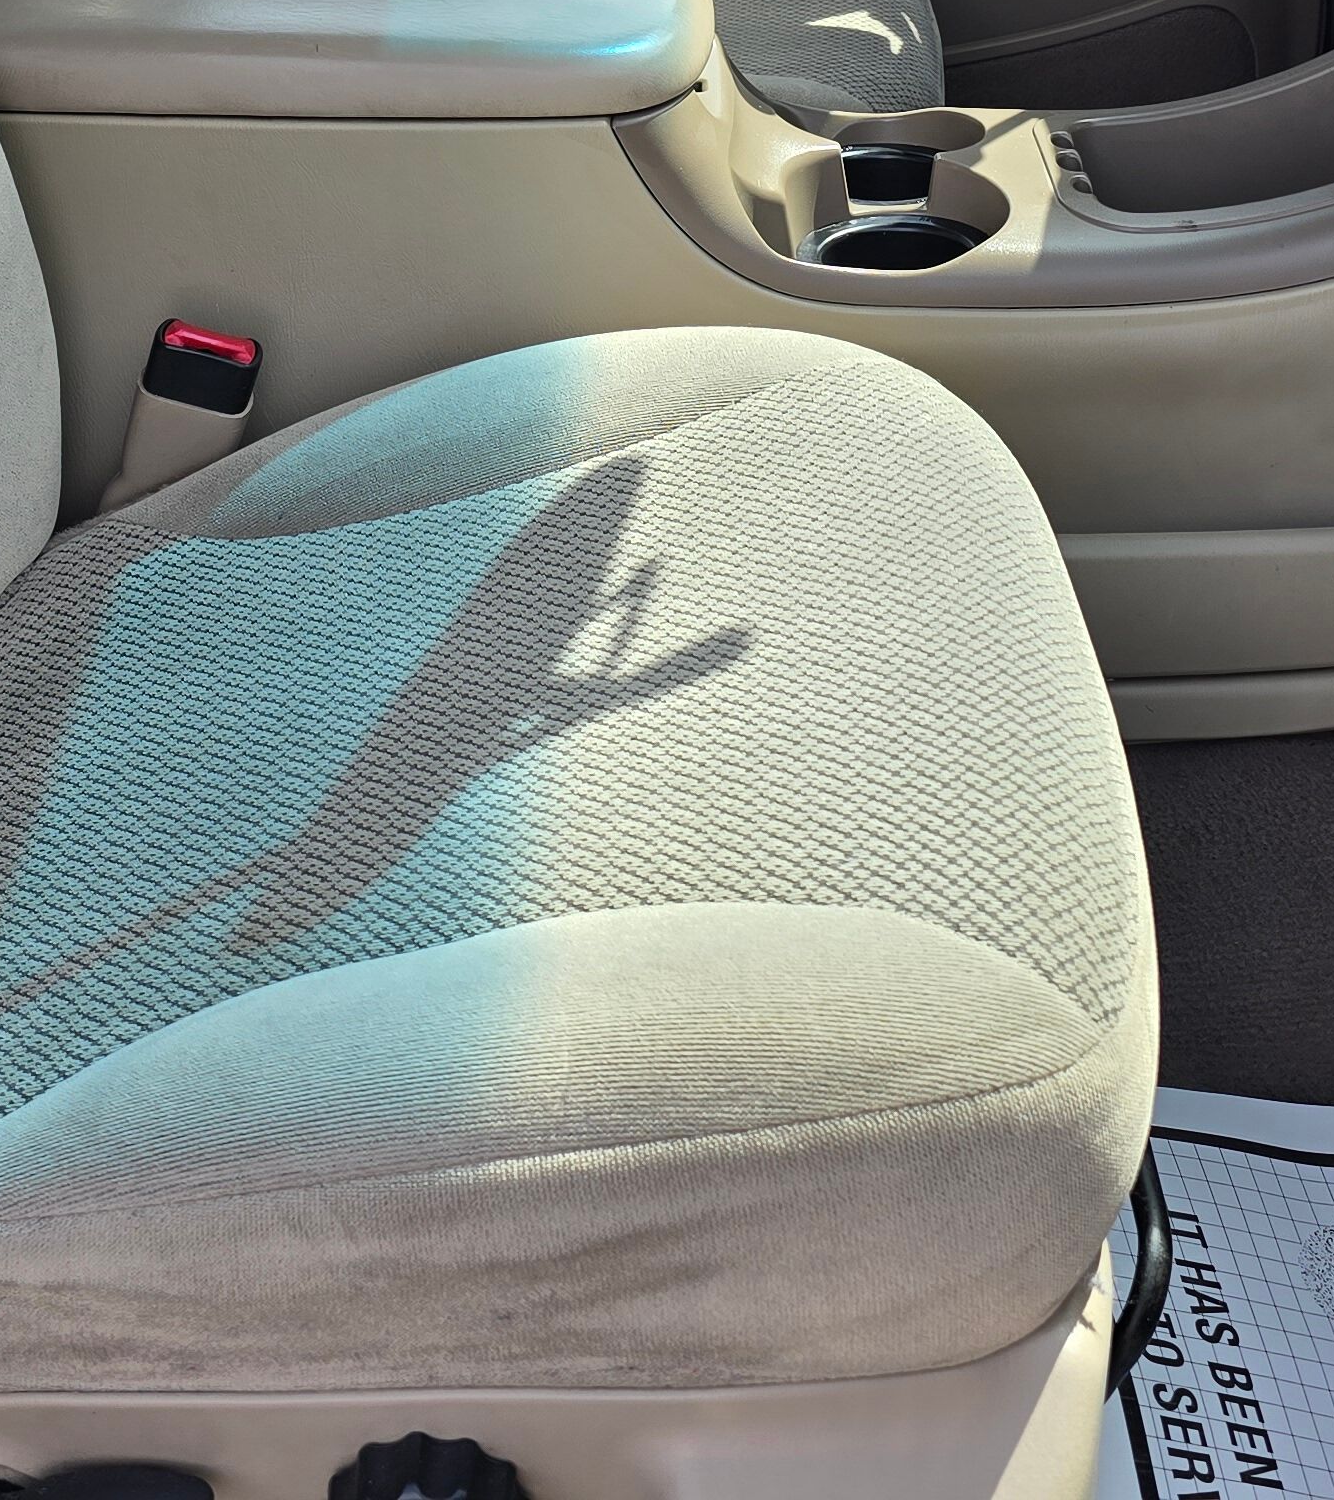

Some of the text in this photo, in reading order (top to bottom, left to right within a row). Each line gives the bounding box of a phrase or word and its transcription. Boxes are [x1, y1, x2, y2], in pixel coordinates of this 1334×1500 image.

[1168, 1210, 1284, 1490] IT HAS BEEN
